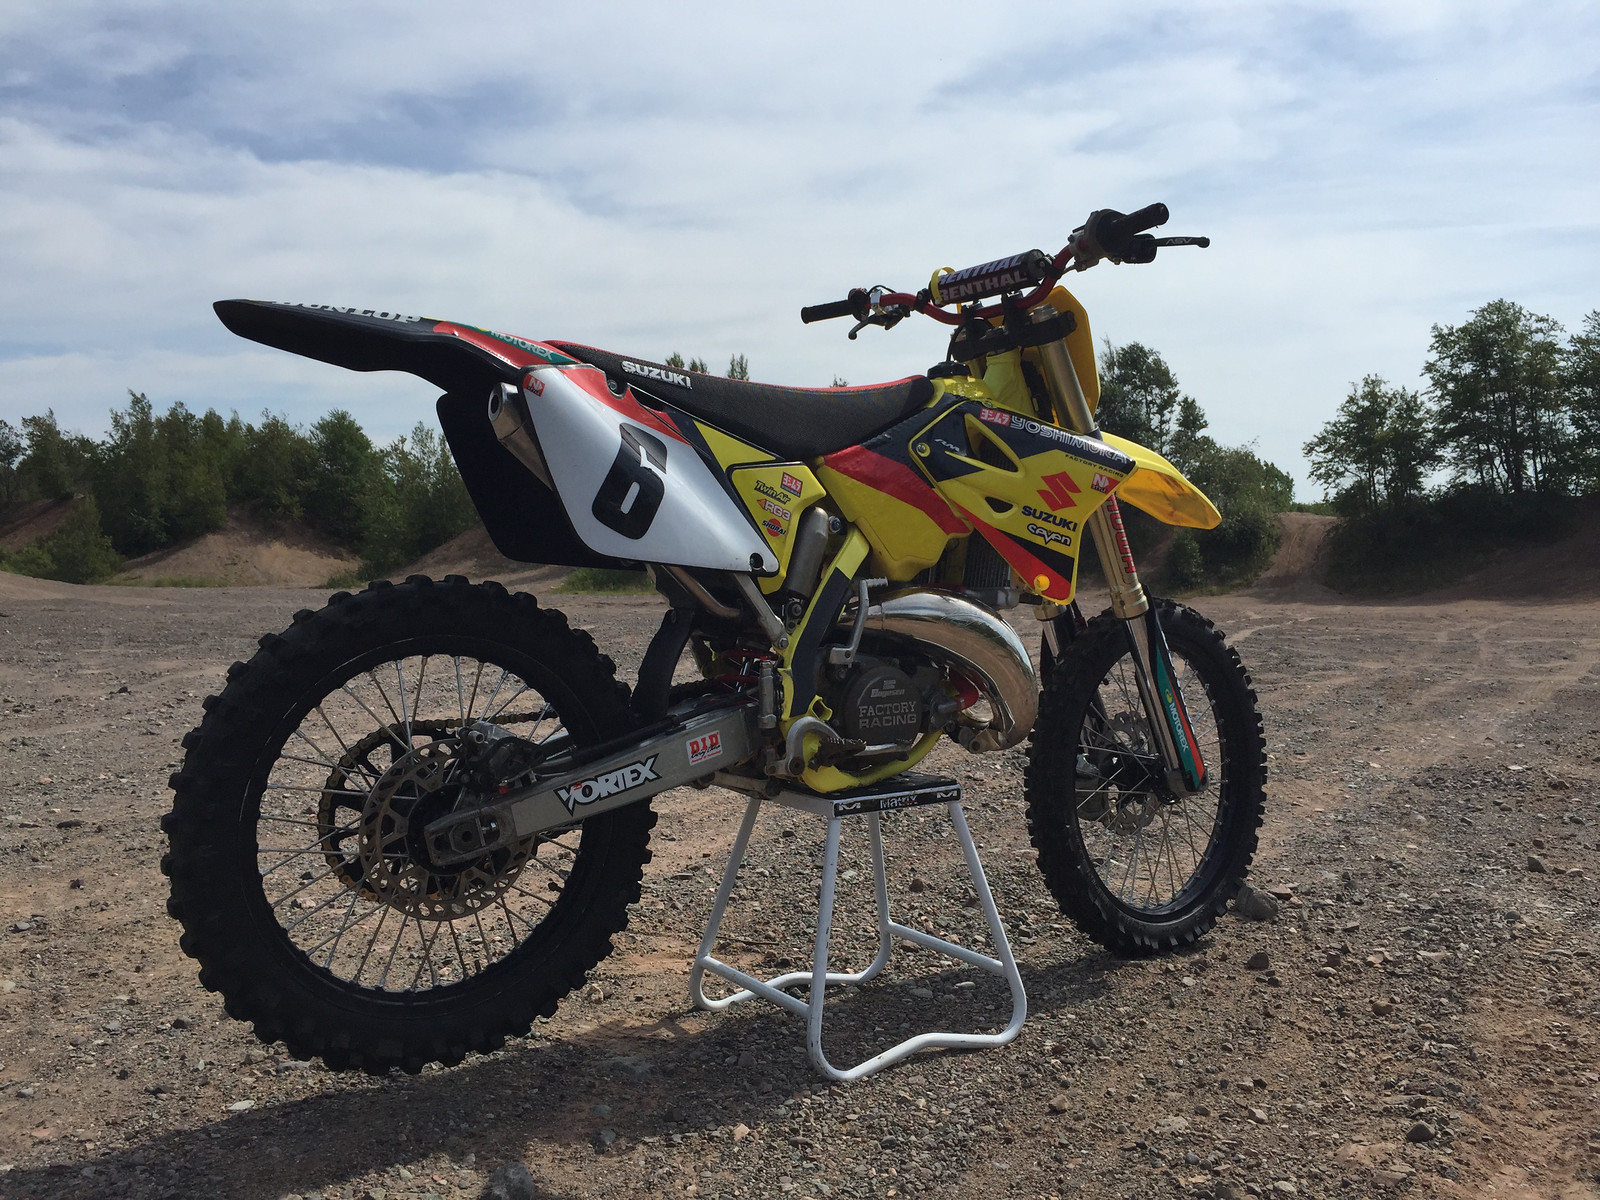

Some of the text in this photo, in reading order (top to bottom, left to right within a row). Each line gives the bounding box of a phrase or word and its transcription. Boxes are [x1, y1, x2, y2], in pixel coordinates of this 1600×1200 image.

[620, 360, 693, 391] SUZUKI
[1064, 454, 1124, 478] FACTORY RACING
[592, 422, 668, 540] 6
[764, 502, 792, 521] RG3
[1021, 505, 1078, 532] SUZUKI
[1107, 493, 1136, 574] HOWA
[858, 701, 917, 717] FACTORY
[858, 713, 917, 729] RACING
[1168, 702, 1190, 752] MOTOREX
[554, 755, 661, 814] VORTEX
